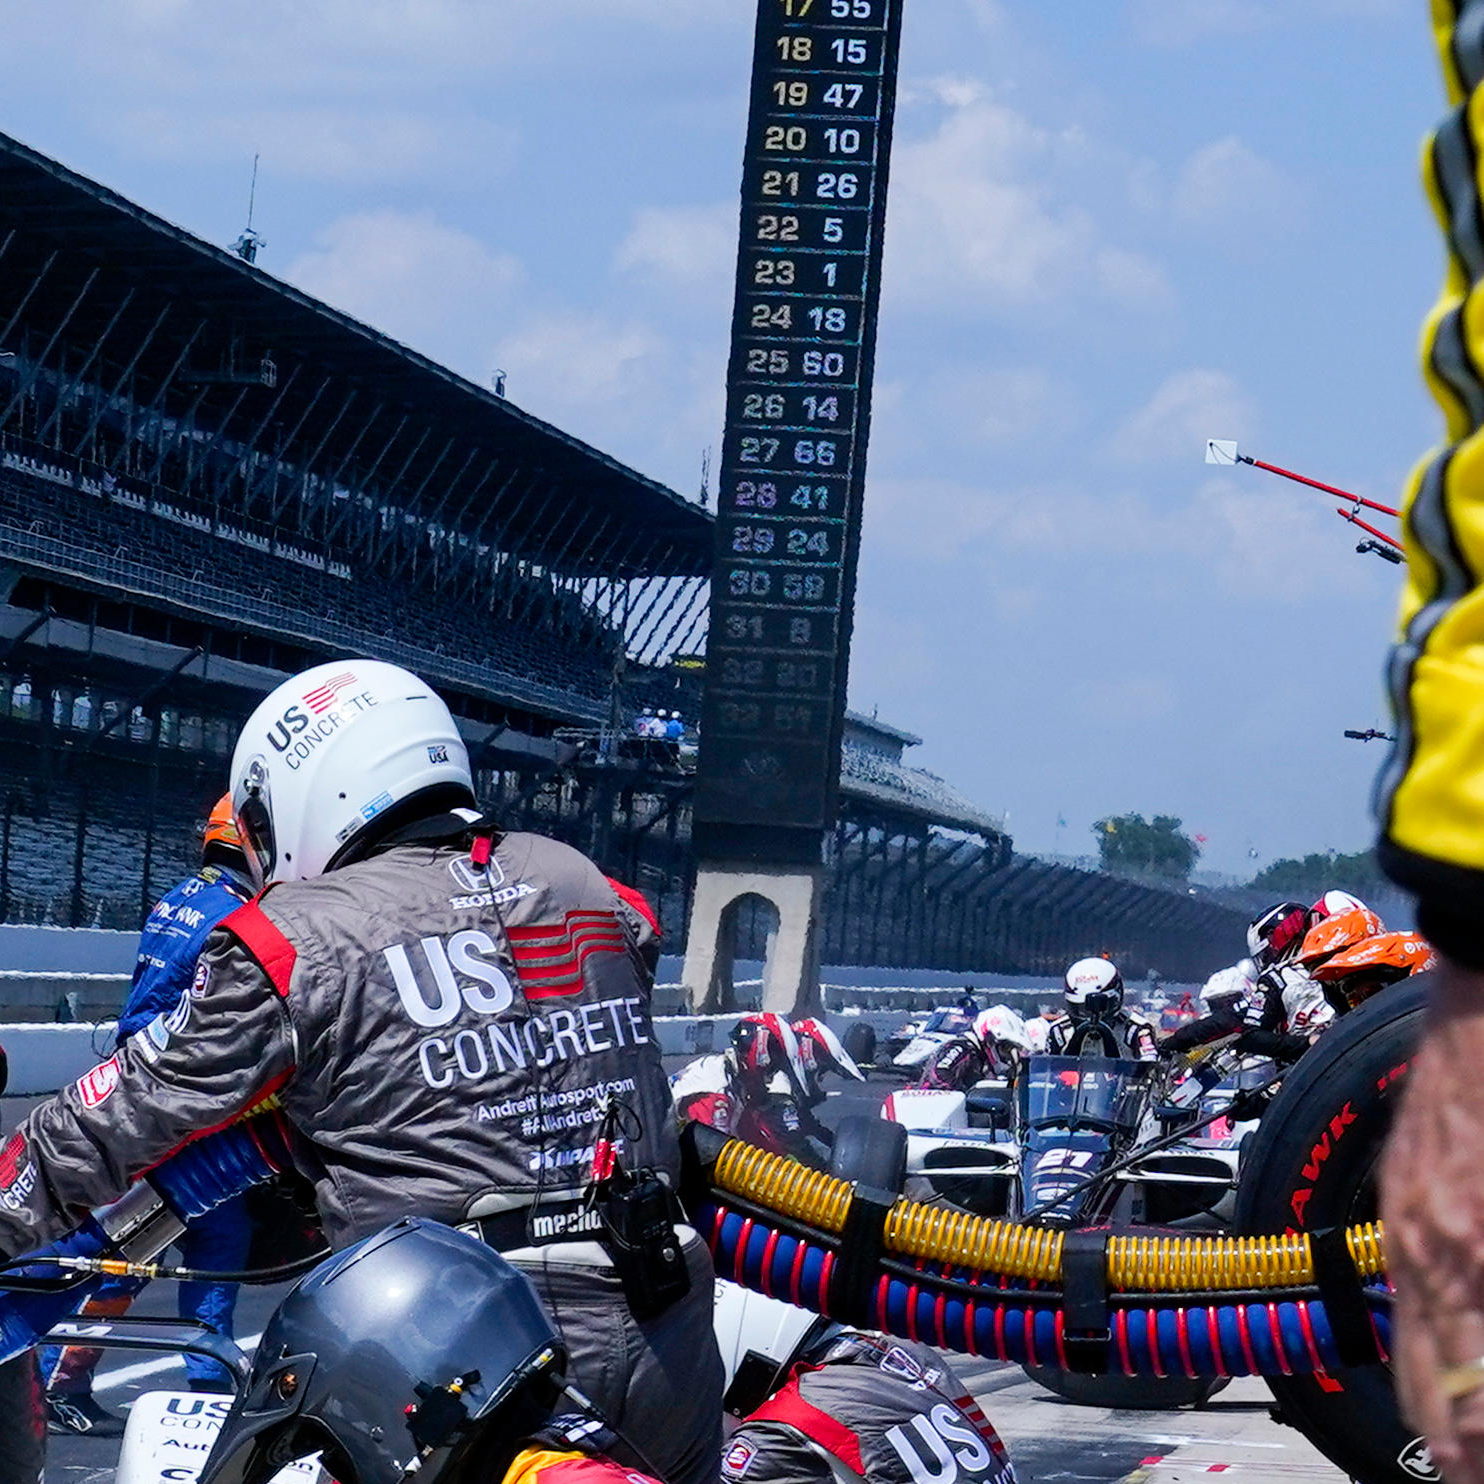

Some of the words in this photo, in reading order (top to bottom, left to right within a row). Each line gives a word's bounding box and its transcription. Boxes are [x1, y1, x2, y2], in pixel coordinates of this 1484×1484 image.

[777, 36, 812, 62] 18
[831, 38, 867, 64] 15
[773, 81, 808, 107] 19
[823, 83, 863, 109] 47
[764, 126, 807, 151] 20
[823, 128, 860, 154] 10
[762, 170, 799, 197] 21
[816, 172, 858, 199] 26
[757, 215, 799, 242] 22
[822, 217, 844, 243] 5
[754, 260, 795, 286] 23
[822, 261, 838, 287] 1
[751, 304, 792, 329] 24
[807, 306, 846, 332] 18
[746, 348, 790, 375] 25
[802, 350, 844, 377] 60
[742, 393, 785, 419] 26
[802, 395, 840, 422] 14
[740, 436, 780, 463] 27
[794, 440, 837, 466] 66
[736, 481, 777, 509] 28
[790, 484, 829, 510] 41
[787, 528, 830, 556] 24
[267, 704, 309, 752] US
[449, 881, 537, 910] HONDA
[384, 929, 514, 1029] US
[417, 996, 649, 1090] CONCRETE
